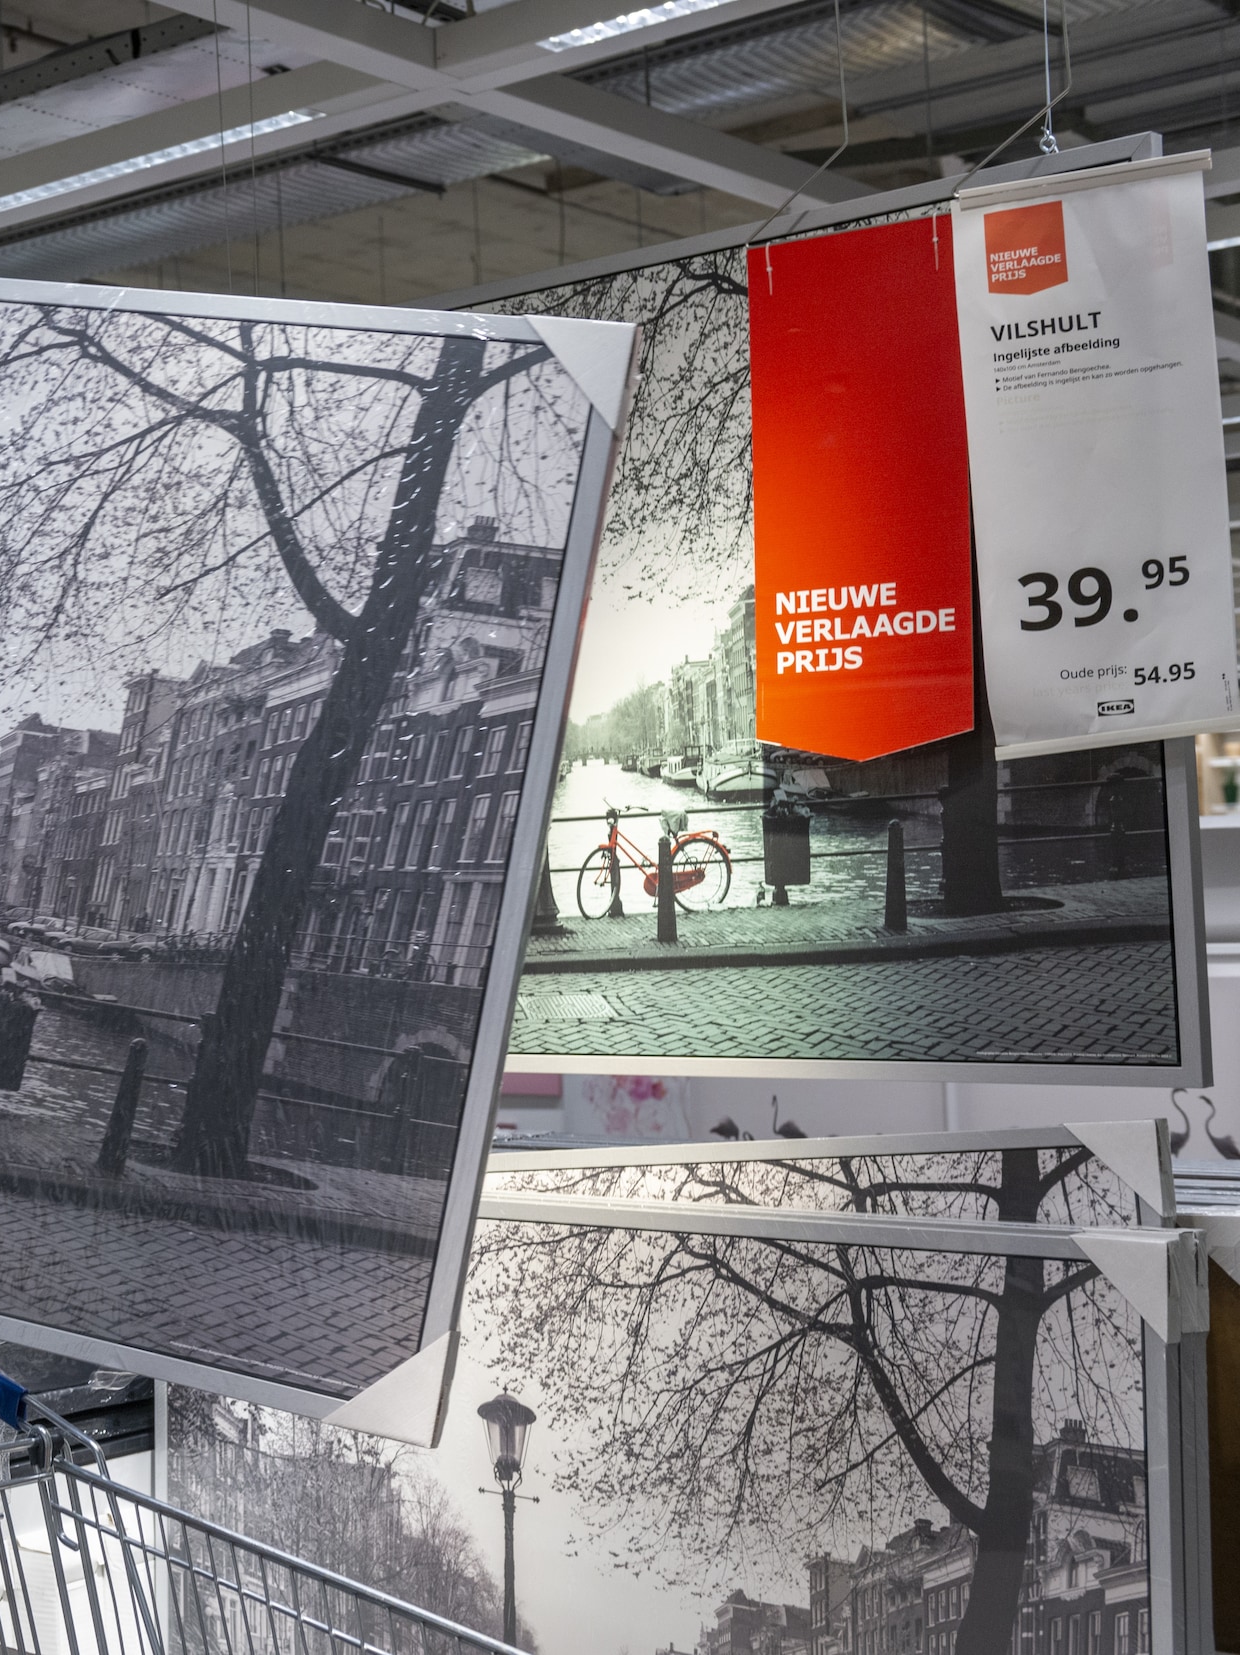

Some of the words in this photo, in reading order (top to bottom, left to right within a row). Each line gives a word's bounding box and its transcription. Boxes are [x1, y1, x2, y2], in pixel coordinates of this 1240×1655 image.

[990, 246, 1038, 261] NIEUWE
[990, 253, 1062, 273] VERLAAGDE
[991, 269, 1026, 283] PRIJS
[990, 311, 1102, 342] VILSHULT
[993, 343, 1051, 363] Ingelijste
[1053, 336, 1121, 356] afbeelding
[1002, 374, 1023, 383] Motief
[1037, 368, 1069, 379] Fernando
[1069, 363, 1111, 376] Bengoechea.
[1002, 384, 1012, 392] De
[1013, 379, 1047, 391] afbeelding
[1055, 375, 1080, 387] ingelijst
[1091, 371, 1103, 380] kan
[1113, 367, 1139, 377] worden
[1140, 360, 1184, 373] opgehangen.
[996, 393, 1041, 406] Picture
[775, 582, 897, 615] NIEUWE
[775, 607, 956, 645] VERLAAGDE
[776, 646, 863, 675] PRIJS
[1060, 666, 1094, 681] Oude
[1097, 664, 1127, 679] prijs:
[1133, 661, 1196, 686] 54.95
[1099, 700, 1134, 715] IKEA
